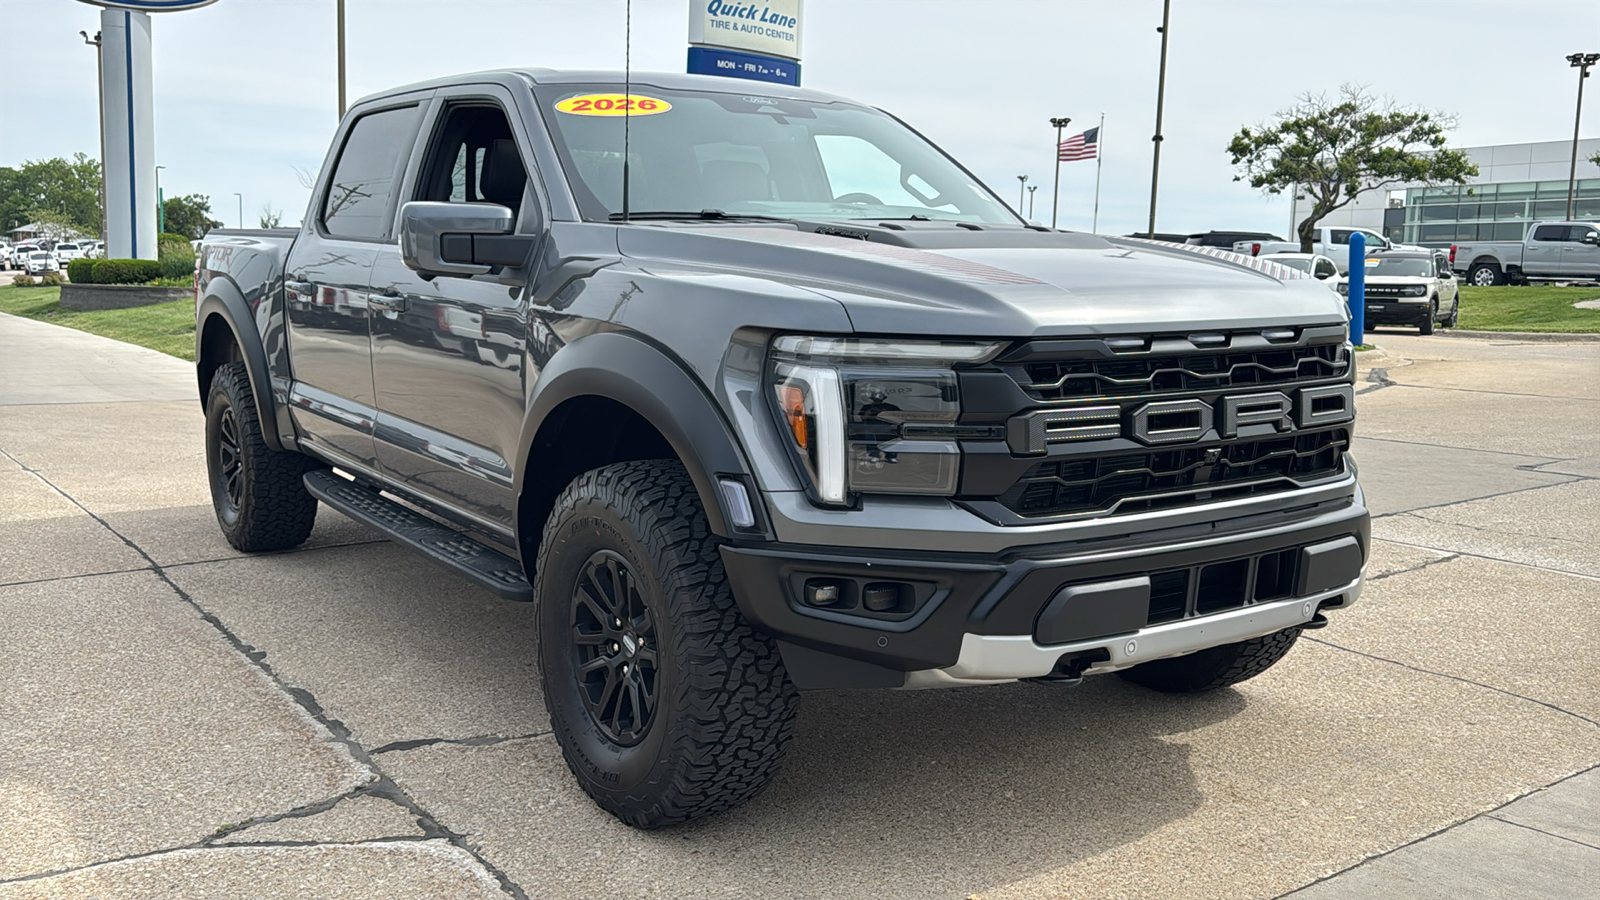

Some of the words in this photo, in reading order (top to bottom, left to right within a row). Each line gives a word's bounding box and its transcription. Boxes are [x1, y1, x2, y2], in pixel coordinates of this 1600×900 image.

[707, 0, 759, 20] Quick
[759, 7, 797, 28] Lane
[709, 19, 731, 30] TIRE
[732, 23, 739, 31] &
[740, 24, 764, 35] AUTO
[765, 28, 795, 42] CENTER
[717, 59, 736, 69] MON
[744, 63, 756, 72] FRI
[571, 99, 658, 112] 2026
[1006, 383, 1355, 458] FORD
